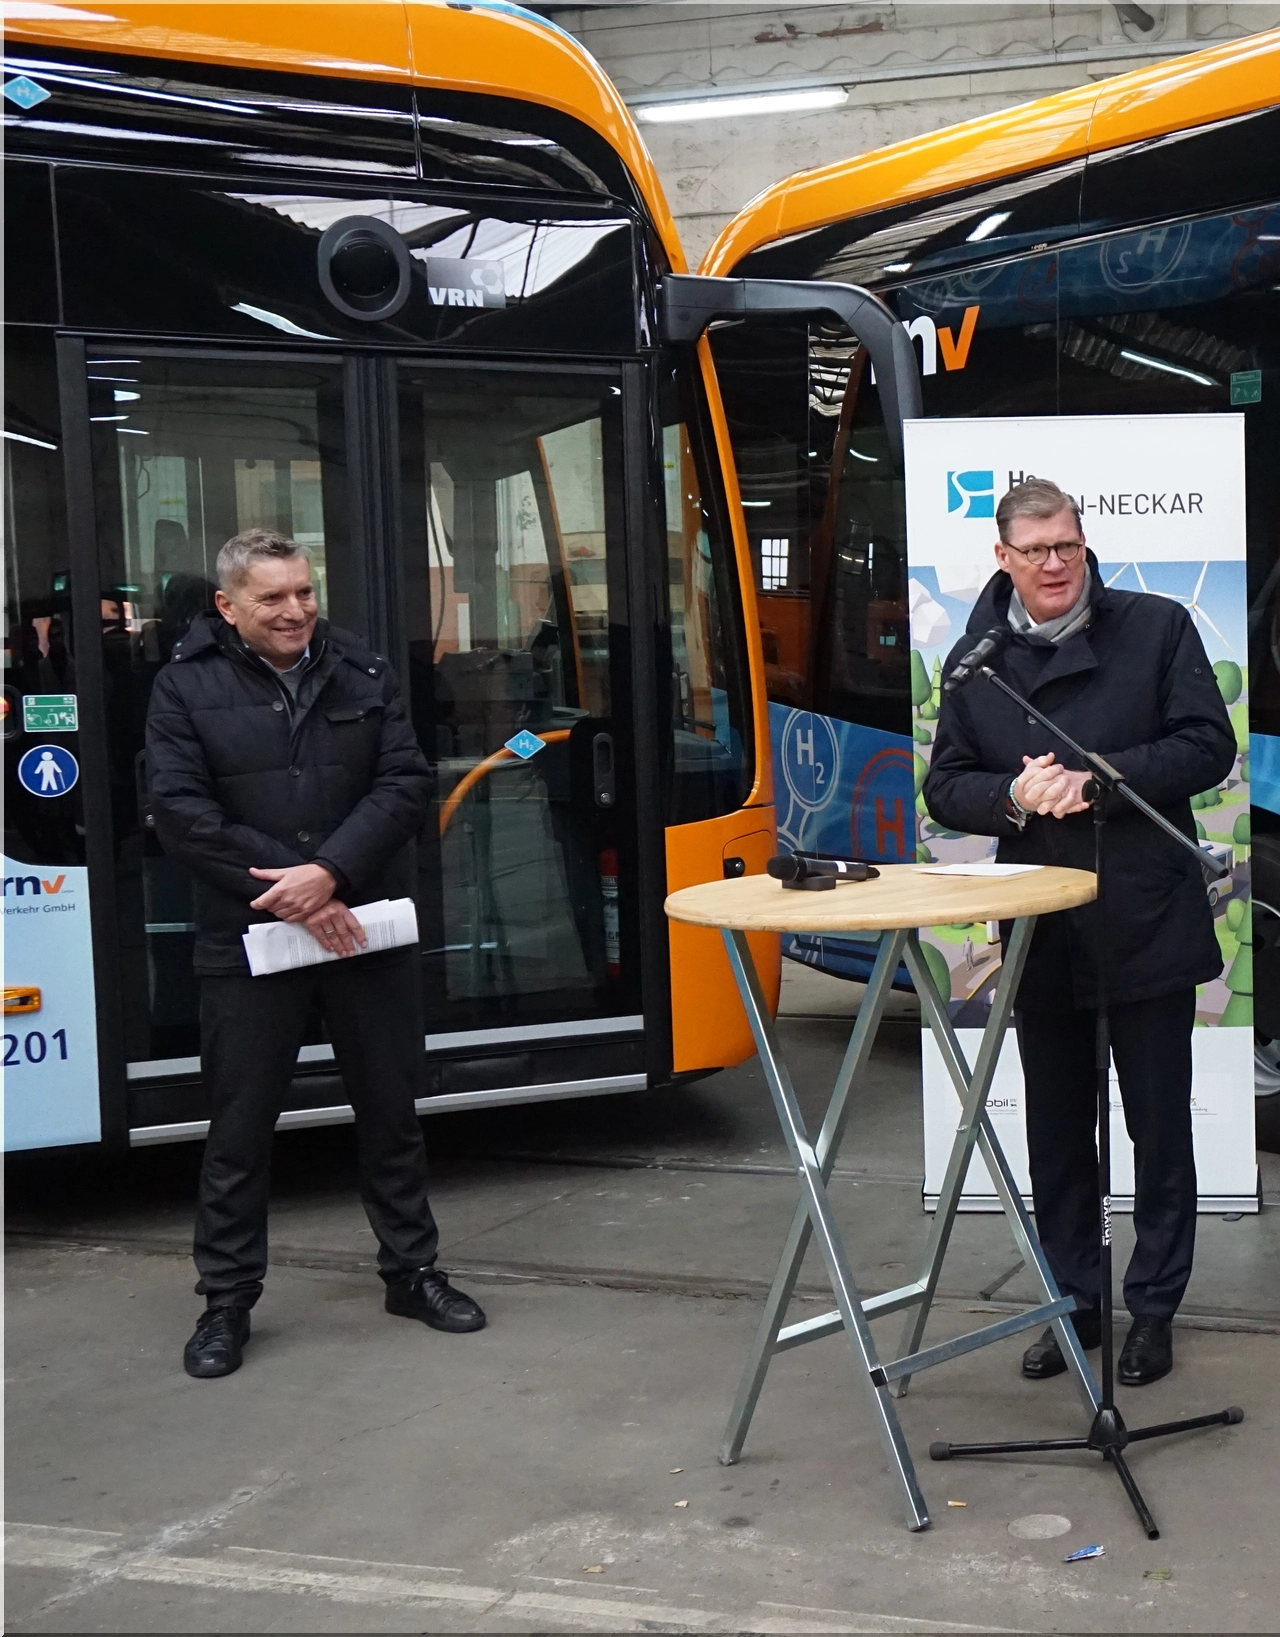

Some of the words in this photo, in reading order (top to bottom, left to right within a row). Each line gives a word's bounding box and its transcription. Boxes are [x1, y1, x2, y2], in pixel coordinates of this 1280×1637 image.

[428, 287, 484, 308] VRN
[871, 305, 980, 385] nv
[1069, 492, 1204, 516] N-NECKAR
[875, 796, 917, 859] H
[0, 874, 67, 897] rnv
[43, 903, 76, 914] GmbH
[985, 1098, 1009, 1108] obil
